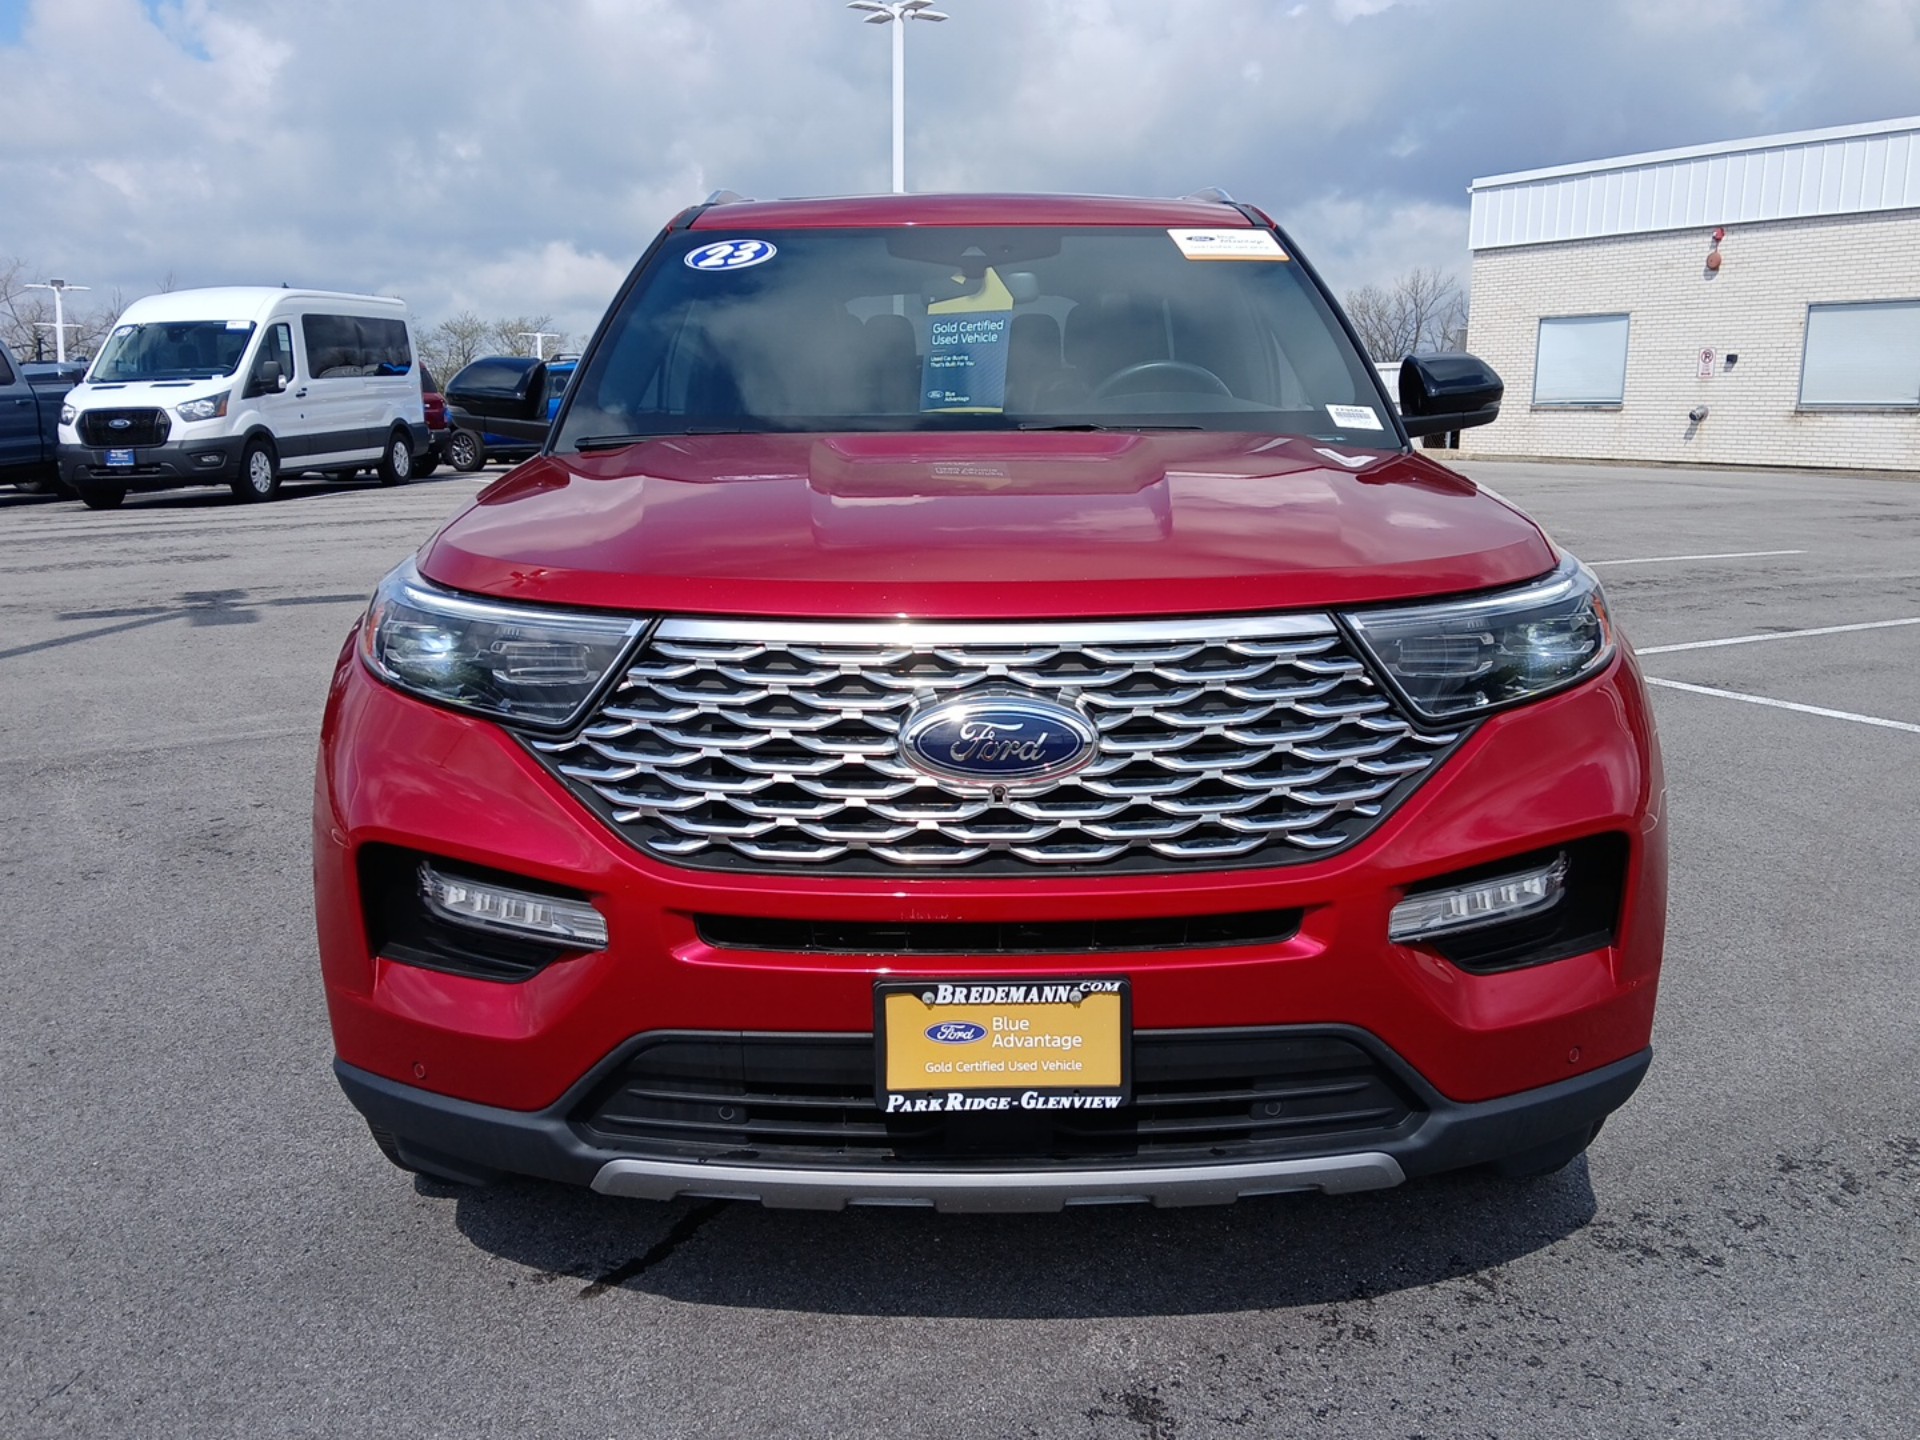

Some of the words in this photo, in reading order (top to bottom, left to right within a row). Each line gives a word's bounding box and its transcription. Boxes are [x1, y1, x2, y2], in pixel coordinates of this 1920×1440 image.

[697, 242, 762, 268] 23
[932, 321, 958, 334] Gold
[959, 319, 1005, 332] Certified
[931, 333, 959, 345] Used
[960, 331, 998, 344] Vehicle
[950, 720, 1049, 762] Ford
[936, 1023, 975, 1040] Ford
[992, 1016, 1030, 1032] Blue
[992, 1033, 1083, 1050] Advantage
[924, 1061, 953, 1073] Gold
[955, 1060, 1005, 1072] Certified
[1008, 1060, 1038, 1071] Used
[1041, 1059, 1083, 1071] Vehicle
[886, 1094, 944, 1112] PARK
